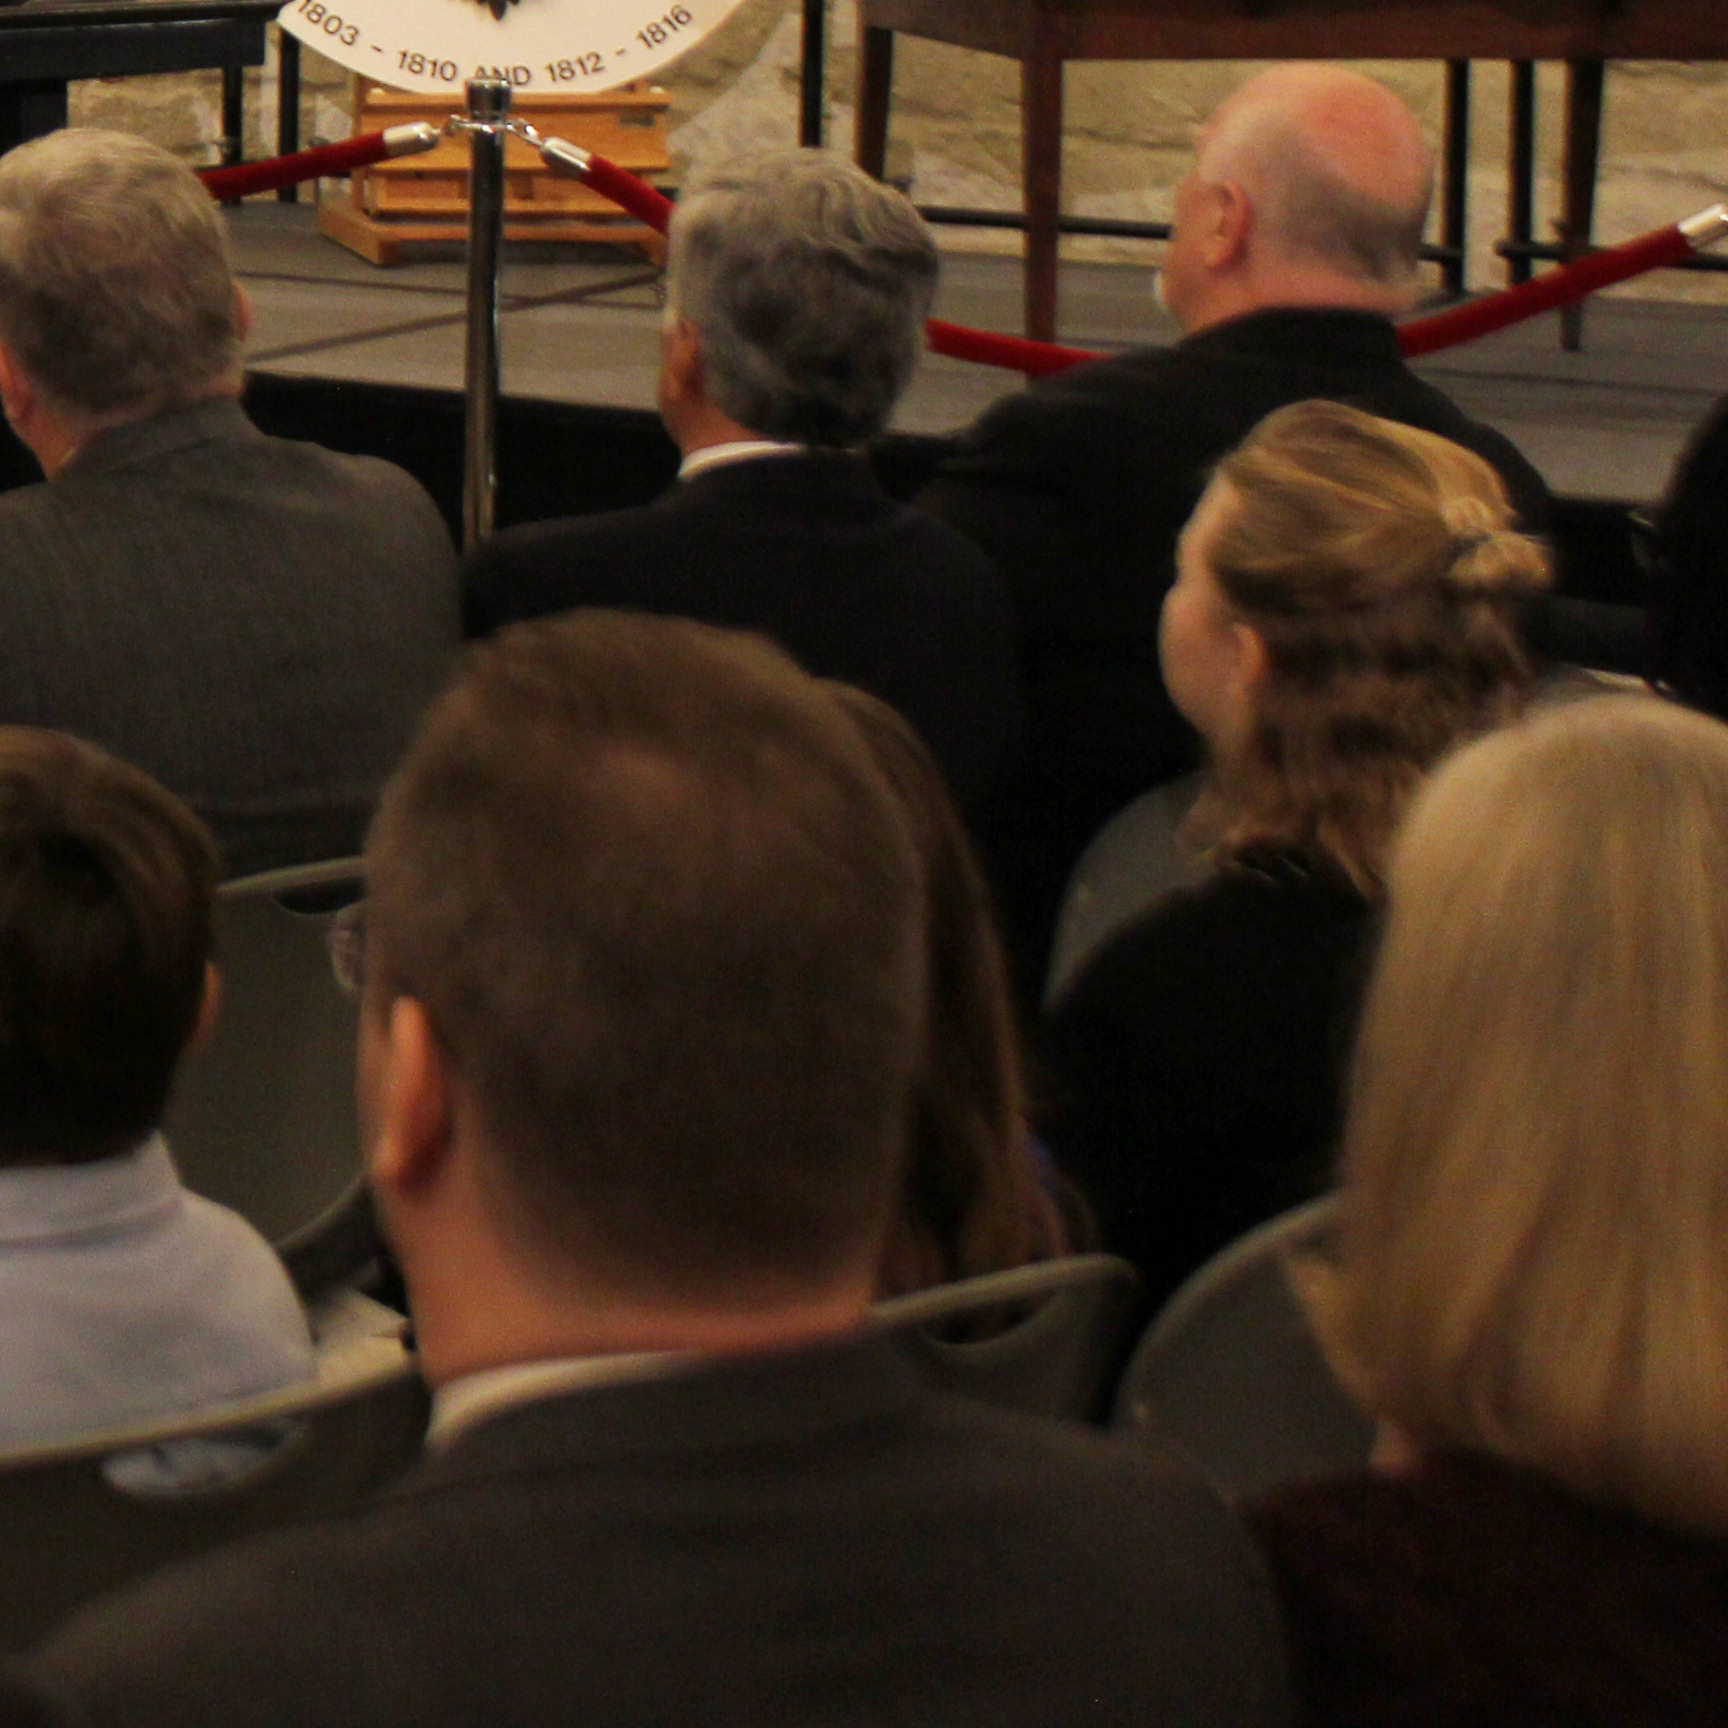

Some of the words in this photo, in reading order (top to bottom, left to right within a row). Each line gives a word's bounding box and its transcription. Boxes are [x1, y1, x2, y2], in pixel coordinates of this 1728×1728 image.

[397, 49, 458, 83] 1810
[473, 65, 532, 86] AND
[544, 52, 606, 83] 1812
[636, 4, 693, 49] 1816
